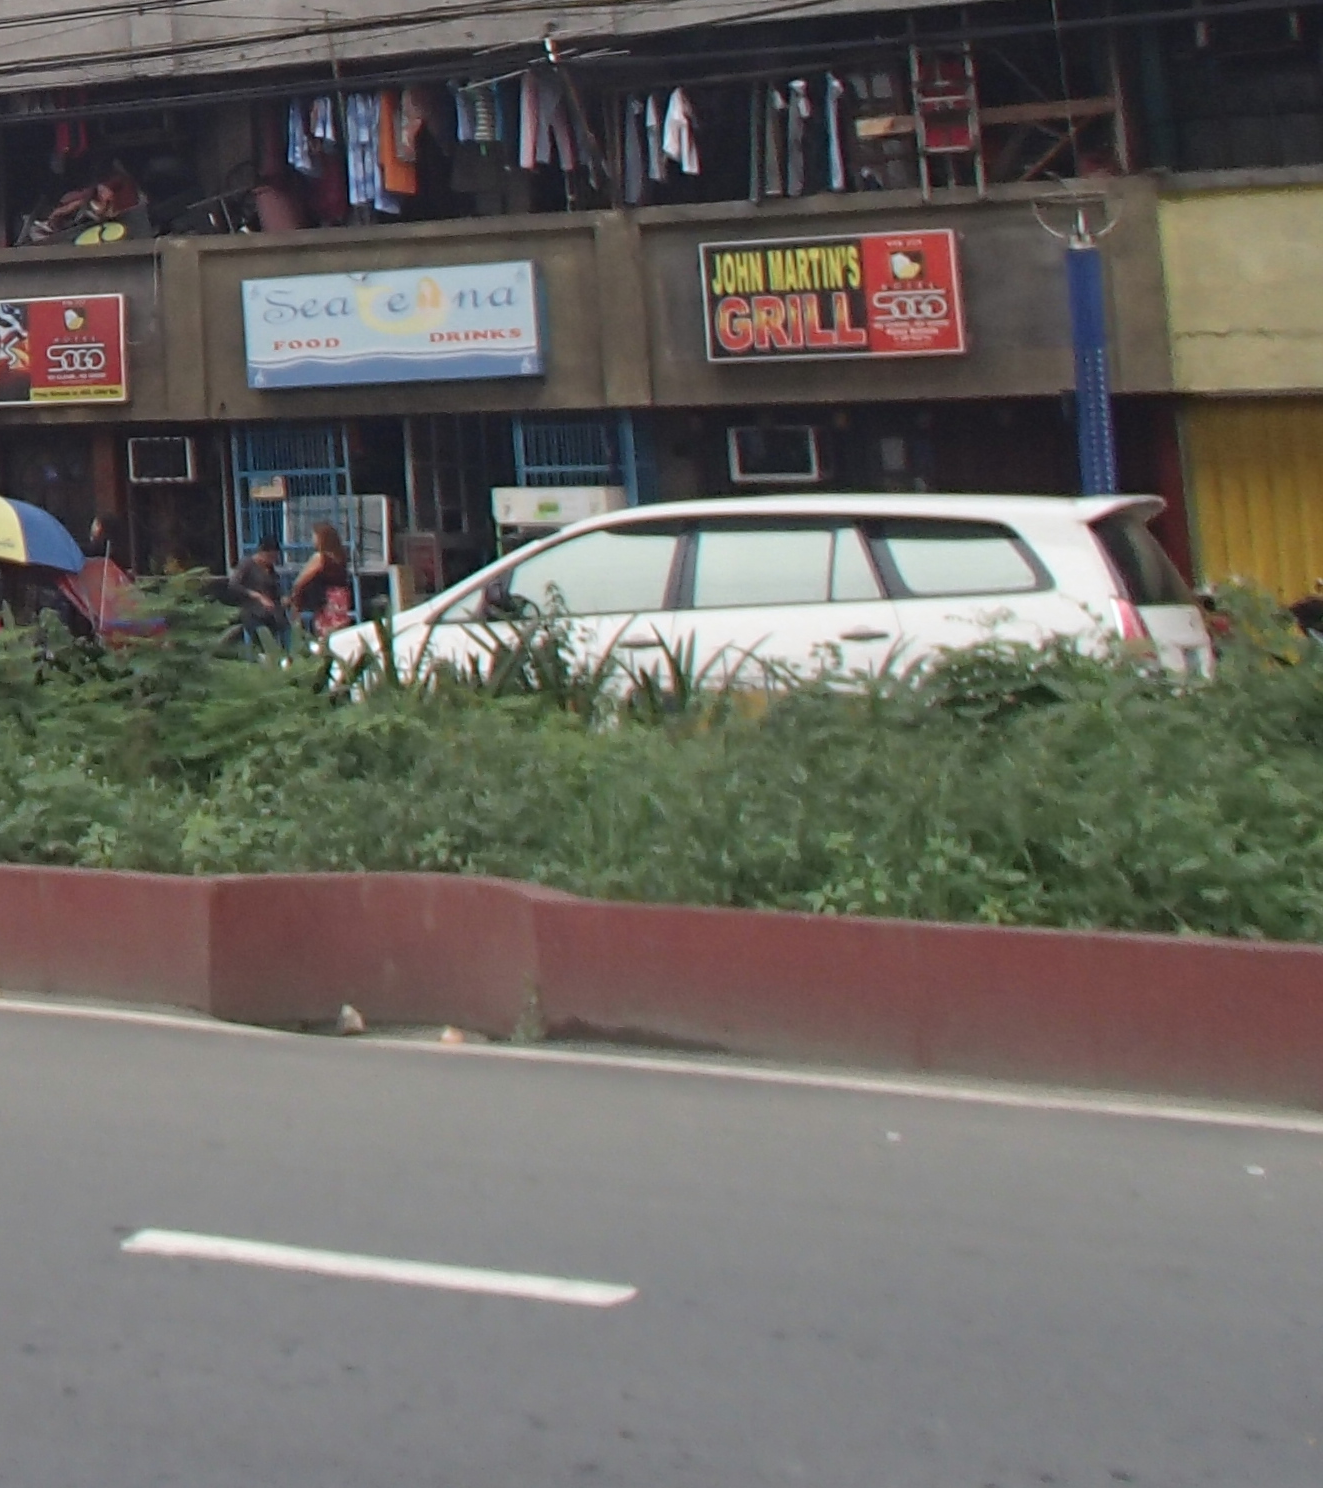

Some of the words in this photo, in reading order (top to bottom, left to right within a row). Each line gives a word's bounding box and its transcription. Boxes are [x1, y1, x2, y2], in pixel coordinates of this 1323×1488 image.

[712, 251, 764, 295] JOHN
[766, 244, 862, 292] MARTIN'S
[263, 290, 351, 325] Sea
[872, 288, 948, 320] SOGO
[429, 326, 523, 344] DRINKS
[715, 291, 869, 350] GRILL
[46, 343, 106, 372] SOGO
[272, 337, 341, 351] FOOD
